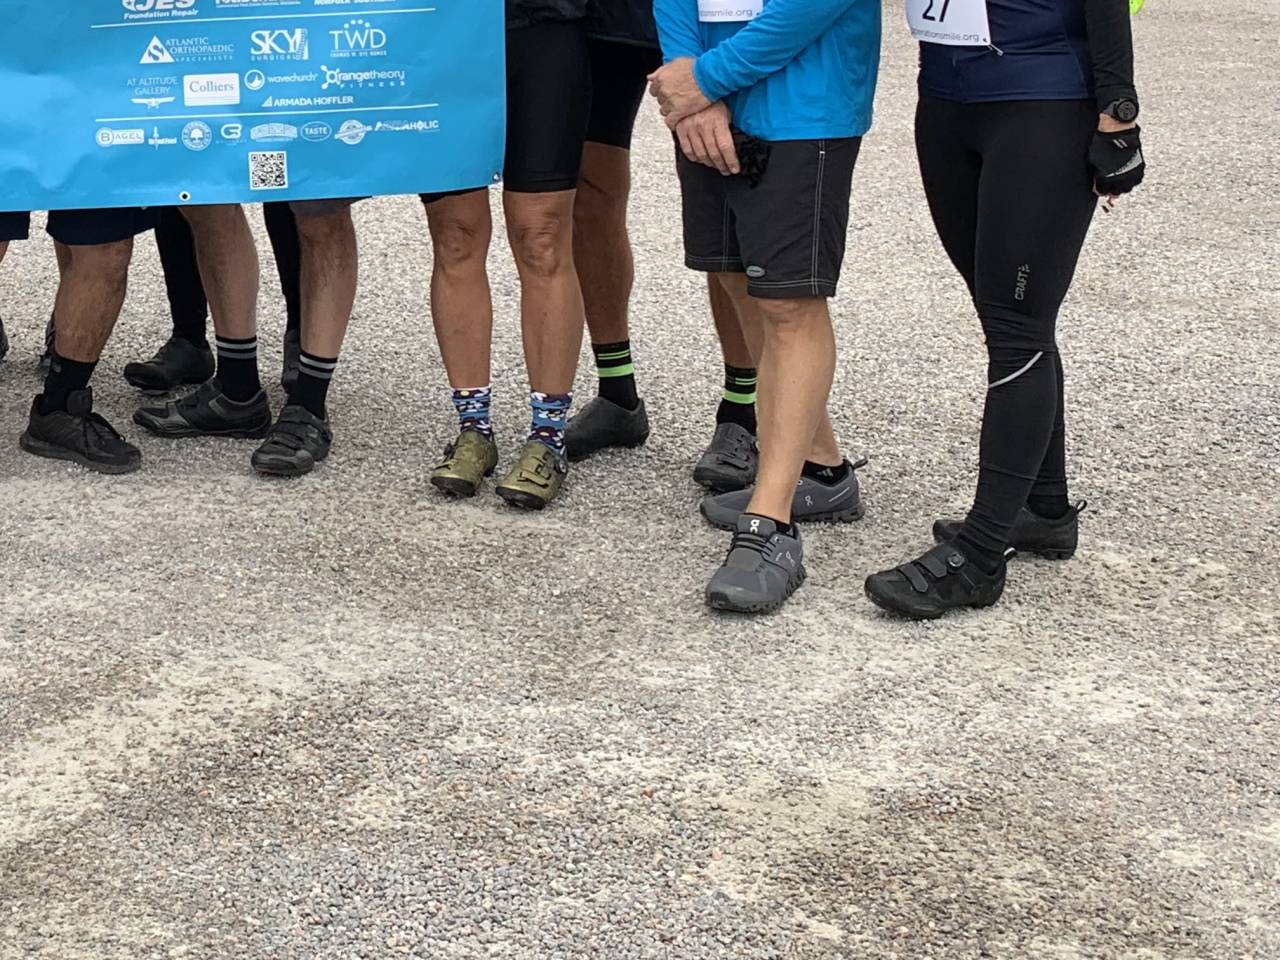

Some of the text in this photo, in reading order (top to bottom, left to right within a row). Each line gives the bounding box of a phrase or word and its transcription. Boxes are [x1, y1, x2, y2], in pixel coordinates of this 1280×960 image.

[124, 9, 199, 20] Foundation Repair
[165, 37, 209, 46] ATLANTIC
[250, 28, 302, 55] SKY
[329, 29, 387, 50] TWD
[170, 44, 235, 54] ORTHOPAEDIC
[127, 76, 178, 87] AT ALTITUDE
[189, 81, 234, 93] Colliers
[134, 86, 171, 96] GALLERY
[274, 96, 354, 107] ARMADA HOFFLER
[304, 126, 328, 135] TASTE
[1014, 271, 1029, 301] CRAFT
